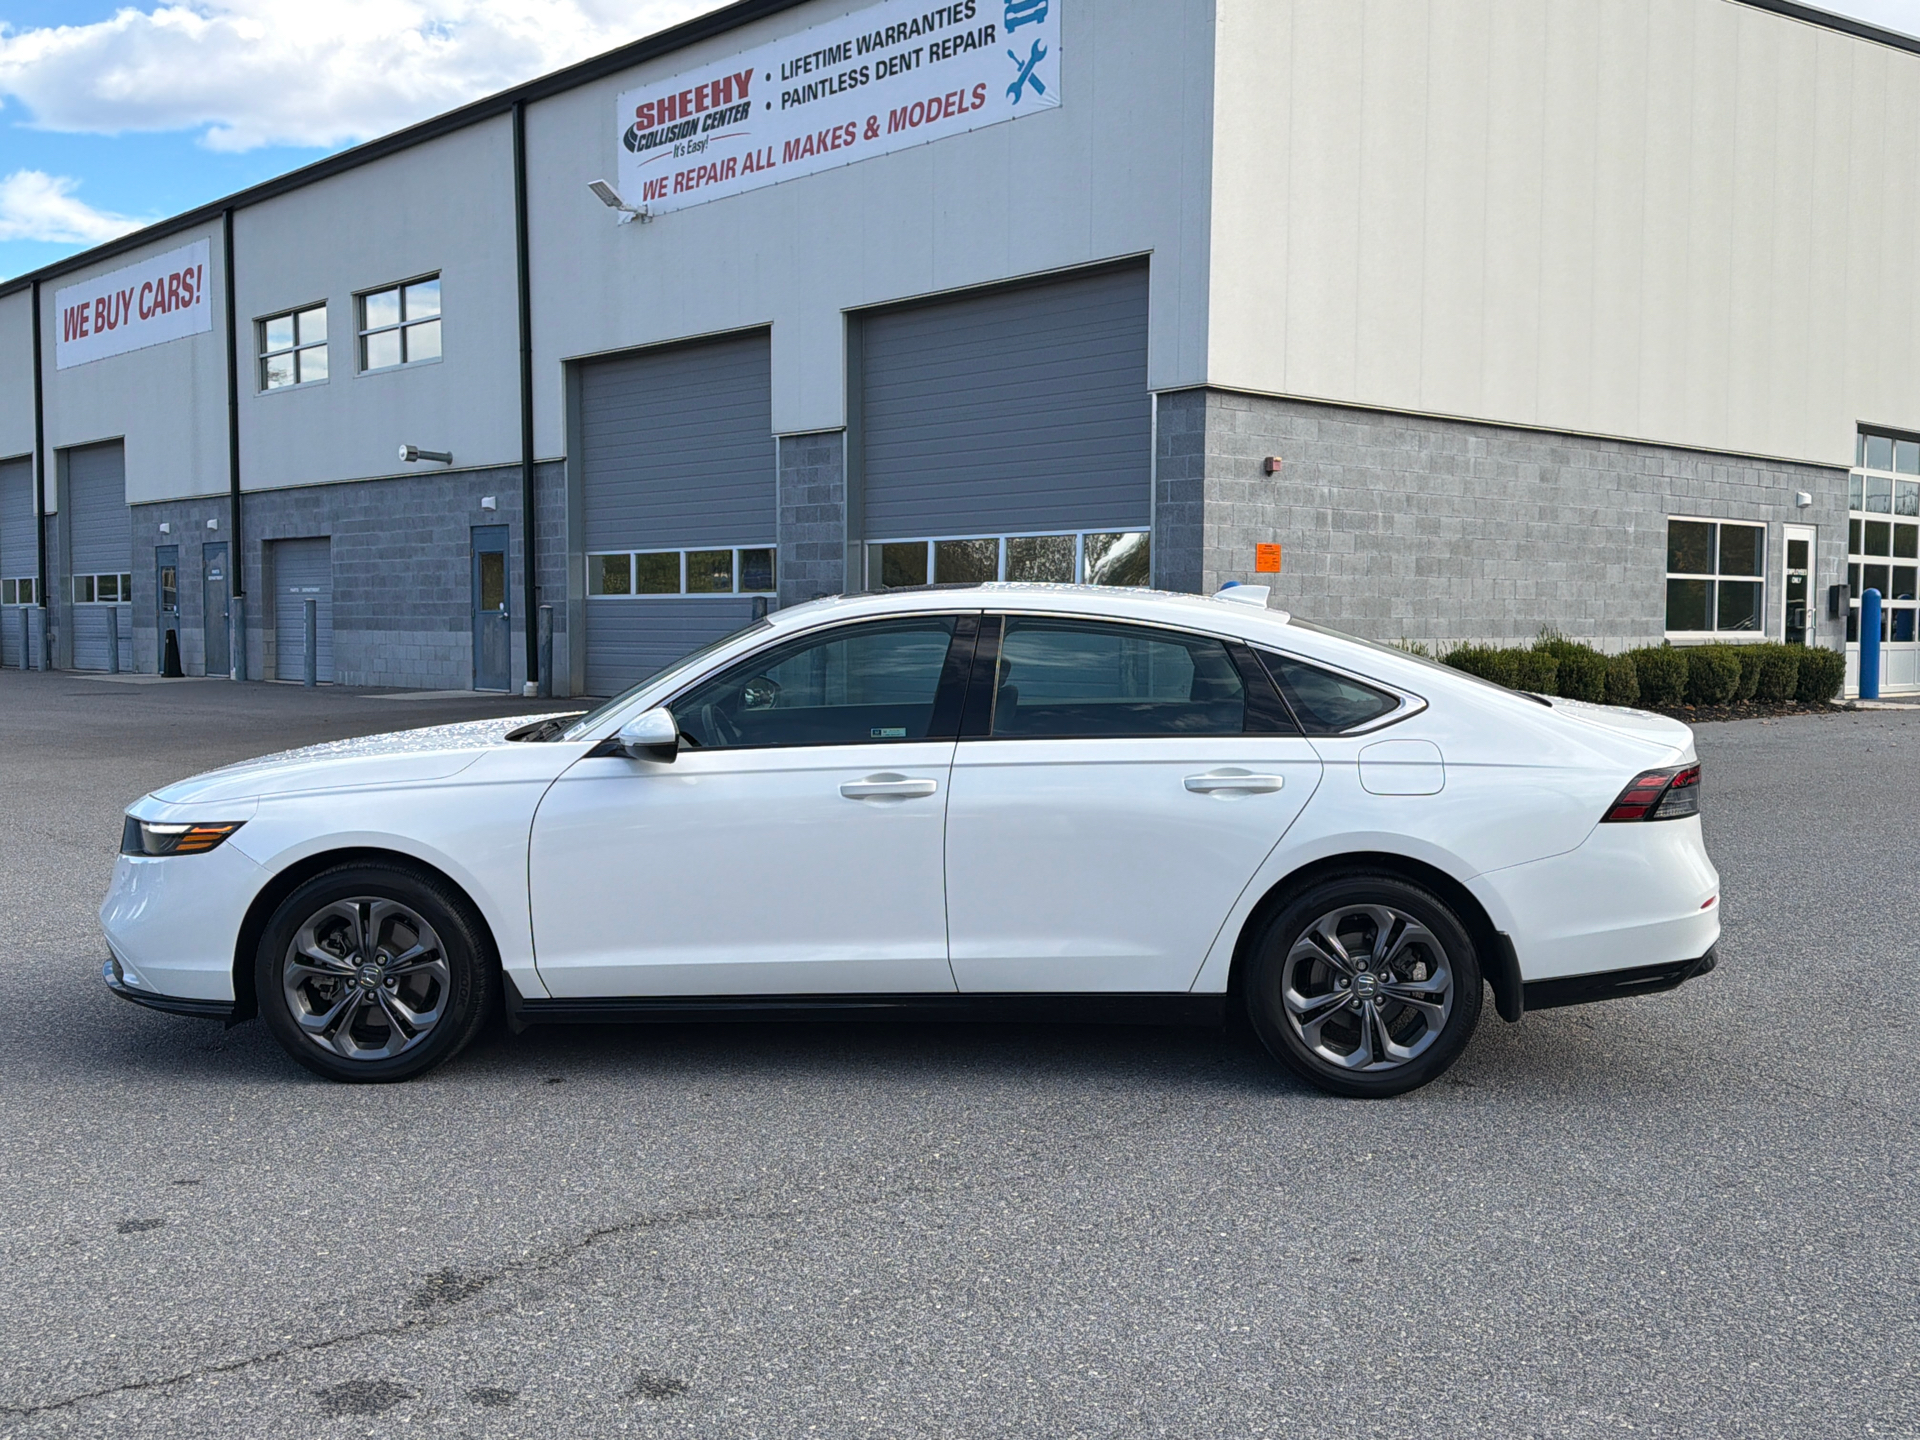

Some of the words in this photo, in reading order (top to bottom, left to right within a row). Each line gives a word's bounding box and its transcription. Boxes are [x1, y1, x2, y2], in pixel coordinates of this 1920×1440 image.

[781, 40, 852, 81] LIFETIME
[855, 0, 977, 57] WARRANTIES
[781, 65, 870, 111] PAINTLESS
[875, 47, 924, 81] DENT
[928, 24, 996, 64] REPAIR
[636, 67, 754, 131] SHEEHY
[636, 117, 701, 152] COLLISION
[701, 101, 752, 133] CENTER
[642, 175, 669, 202] WE
[673, 156, 738, 195] REPAIR
[740, 145, 776, 176] ALL
[782, 121, 857, 164] MAKES
[862, 114, 881, 141] &
[888, 82, 987, 135] MODELS
[686, 134, 709, 155] Easy!
[64, 301, 90, 343] WE
[94, 287, 135, 334] BUY
[138, 264, 203, 321] CARS!
